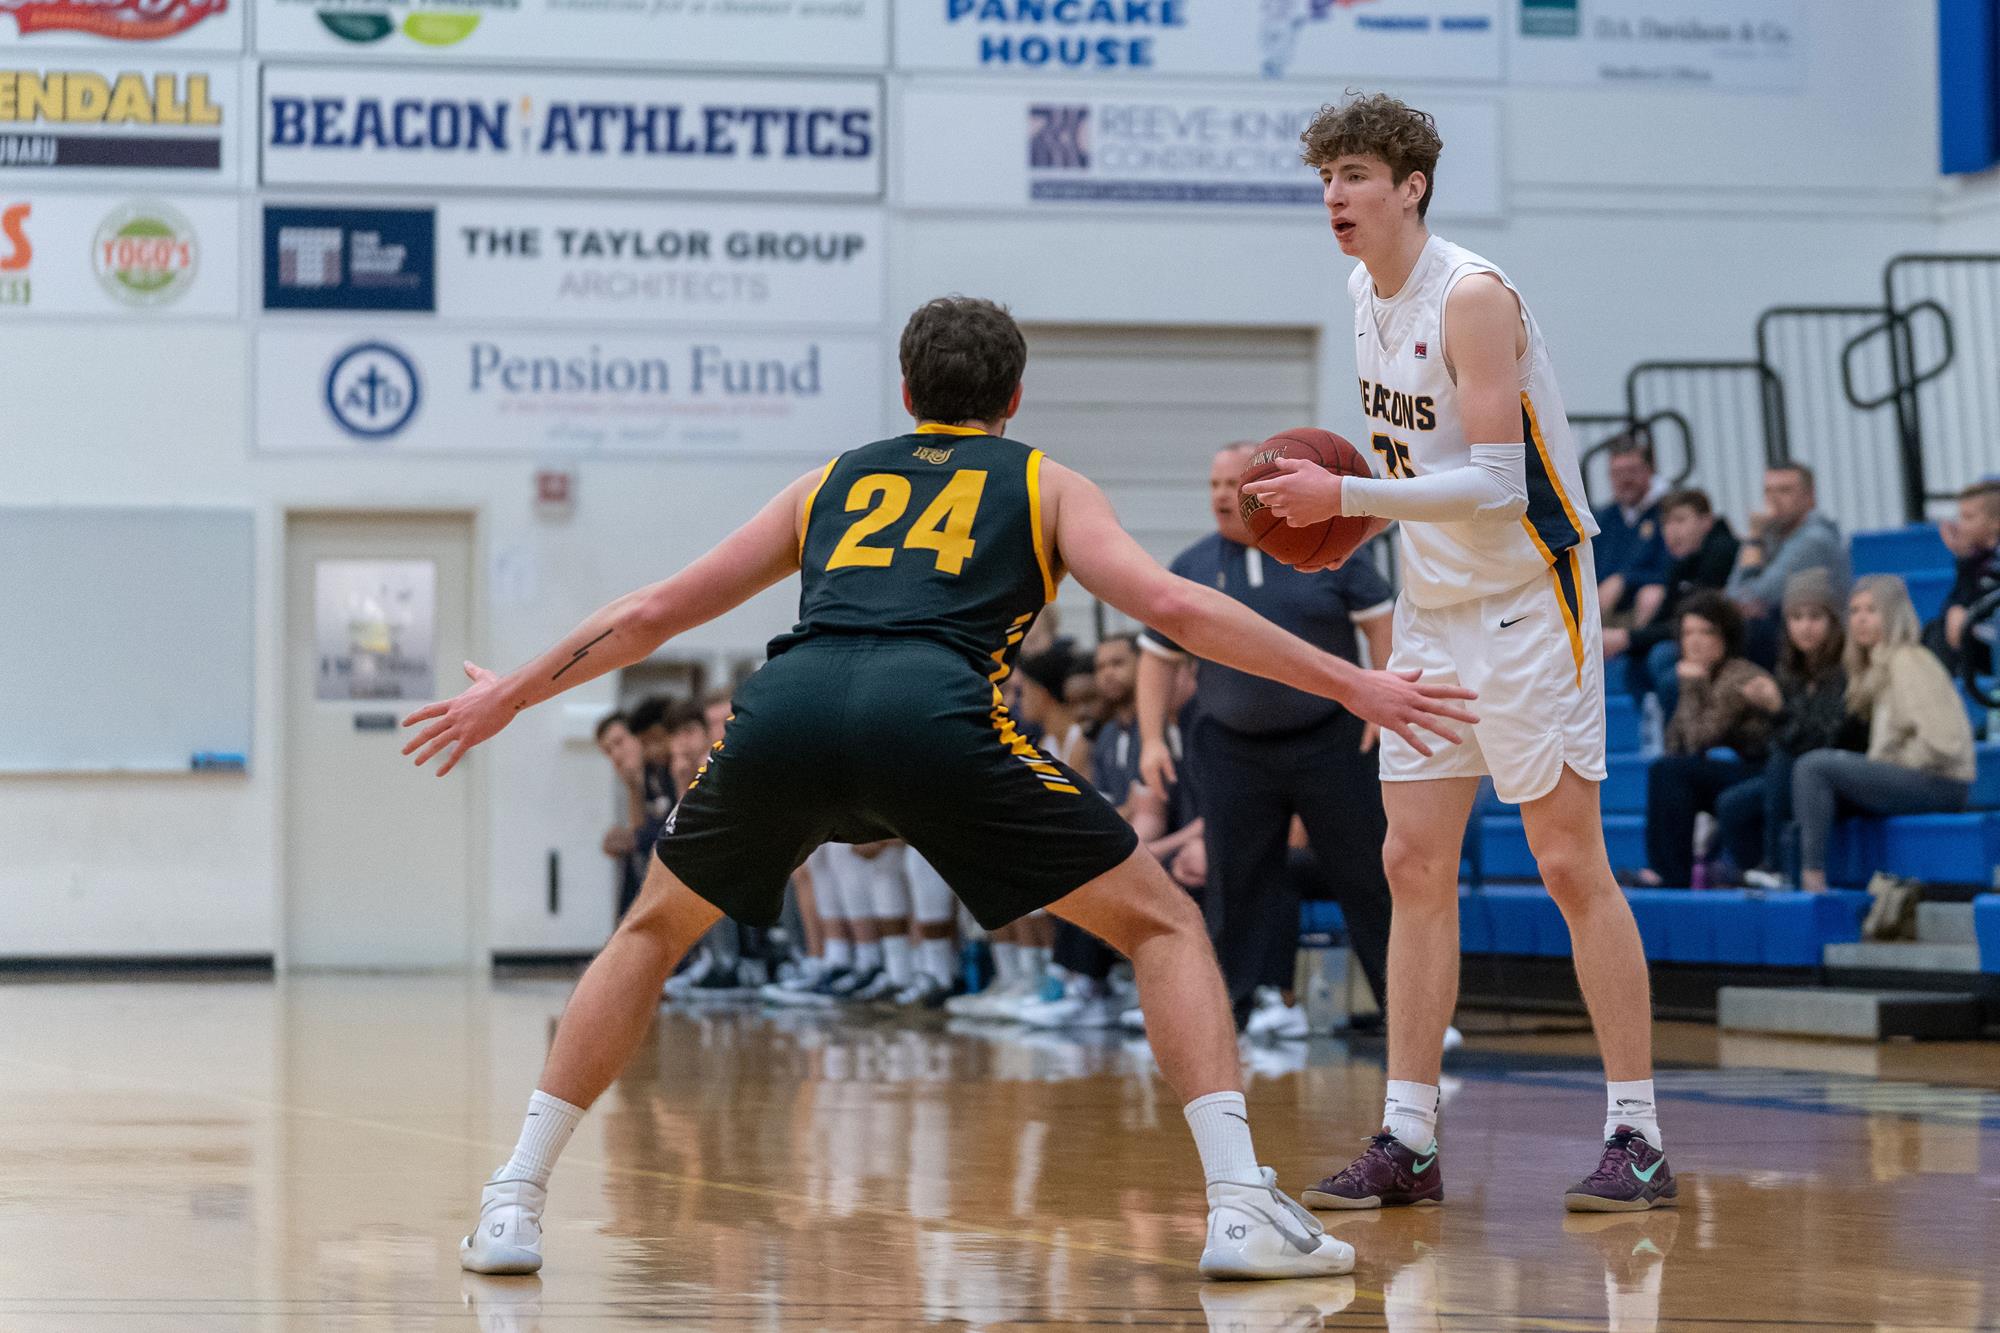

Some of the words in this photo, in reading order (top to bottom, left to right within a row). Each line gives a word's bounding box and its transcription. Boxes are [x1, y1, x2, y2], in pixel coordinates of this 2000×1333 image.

[946, 0, 1186, 27] PANCAKE
[980, 36, 1153, 67] HOUSE
[270, 98, 508, 151] BEACON
[540, 104, 873, 159] ATHLETICS
[462, 228, 539, 257] THE
[557, 230, 710, 260] TAYLOR
[725, 232, 864, 264] GROUP
[559, 271, 771, 303] ARCHITECTS
[470, 342, 669, 393] Pension
[691, 345, 822, 396] Fund
[825, 469, 989, 575] 24
